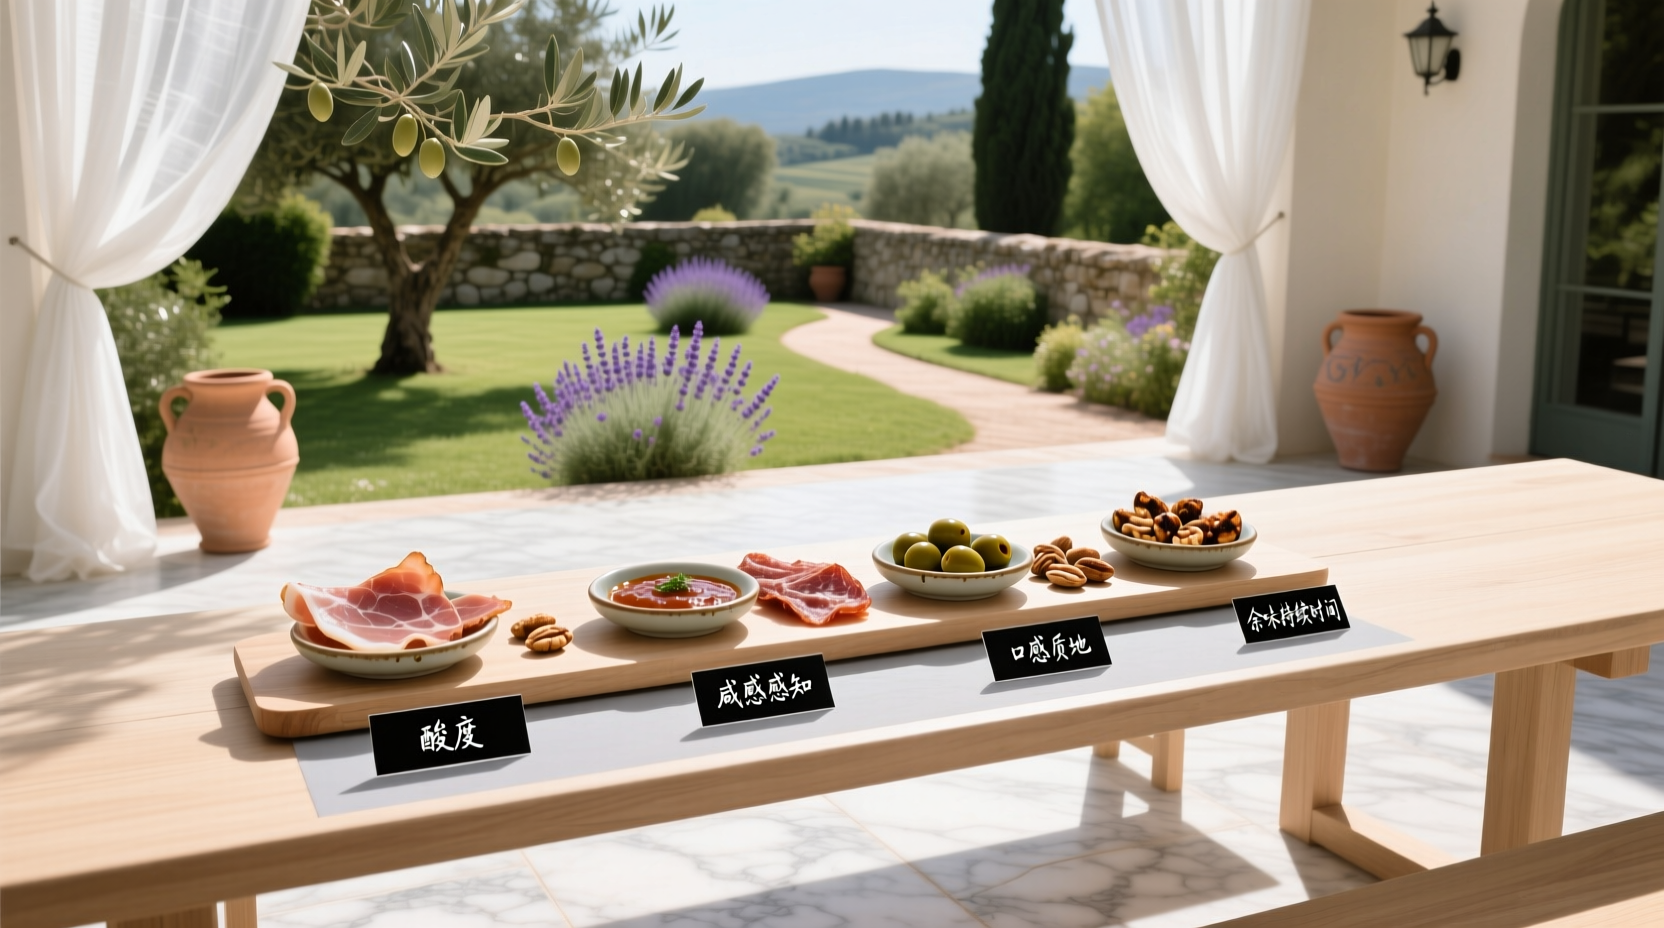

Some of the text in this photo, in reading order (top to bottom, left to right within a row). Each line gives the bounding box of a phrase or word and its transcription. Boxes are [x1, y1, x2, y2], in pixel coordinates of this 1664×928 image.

[1011, 632, 1092, 663] 口感质地
[717, 671, 812, 709] 咸感感知
[420, 715, 485, 752] 酸度
